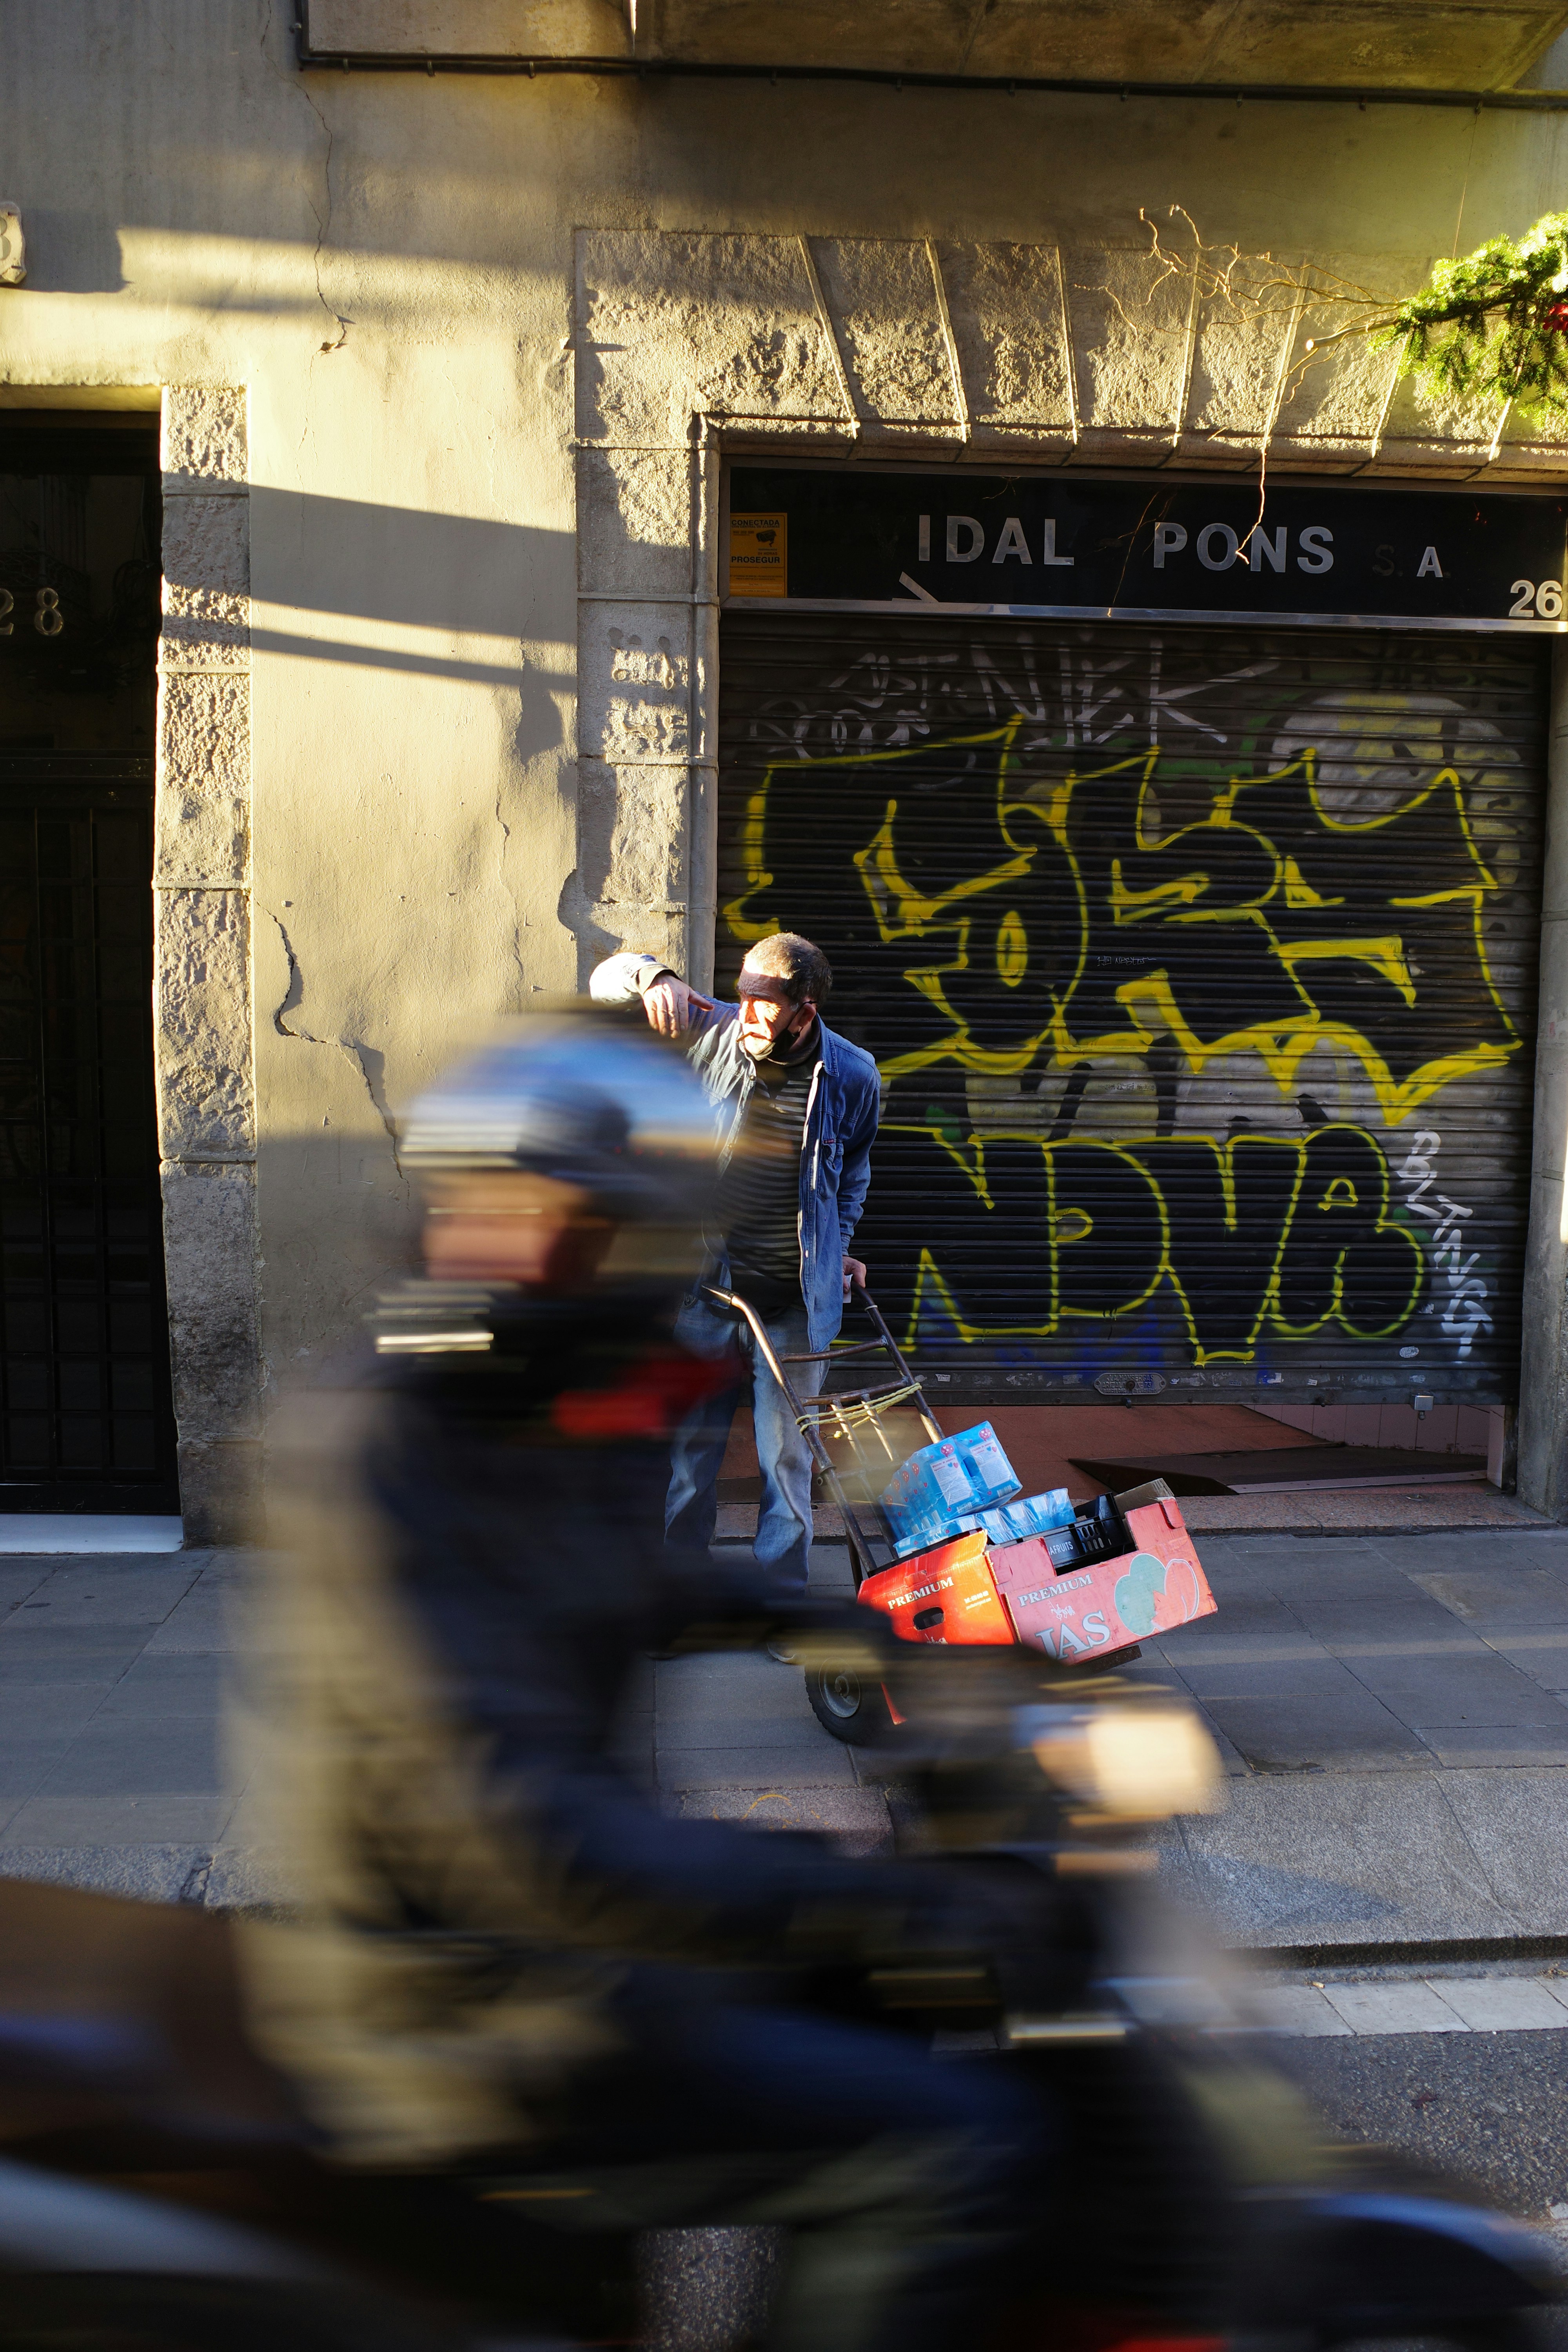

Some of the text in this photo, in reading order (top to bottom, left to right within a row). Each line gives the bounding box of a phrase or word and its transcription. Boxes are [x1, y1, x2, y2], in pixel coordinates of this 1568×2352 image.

[918, 515, 1074, 566] IDAL
[1154, 522, 1333, 573] PONS
[1508, 580, 1563, 618] 26
[1048, 1541, 1074, 1555] AFRUITS
[887, 1576, 955, 1610] PREMIUM
[1018, 1574, 1093, 1607] PREMIUM
